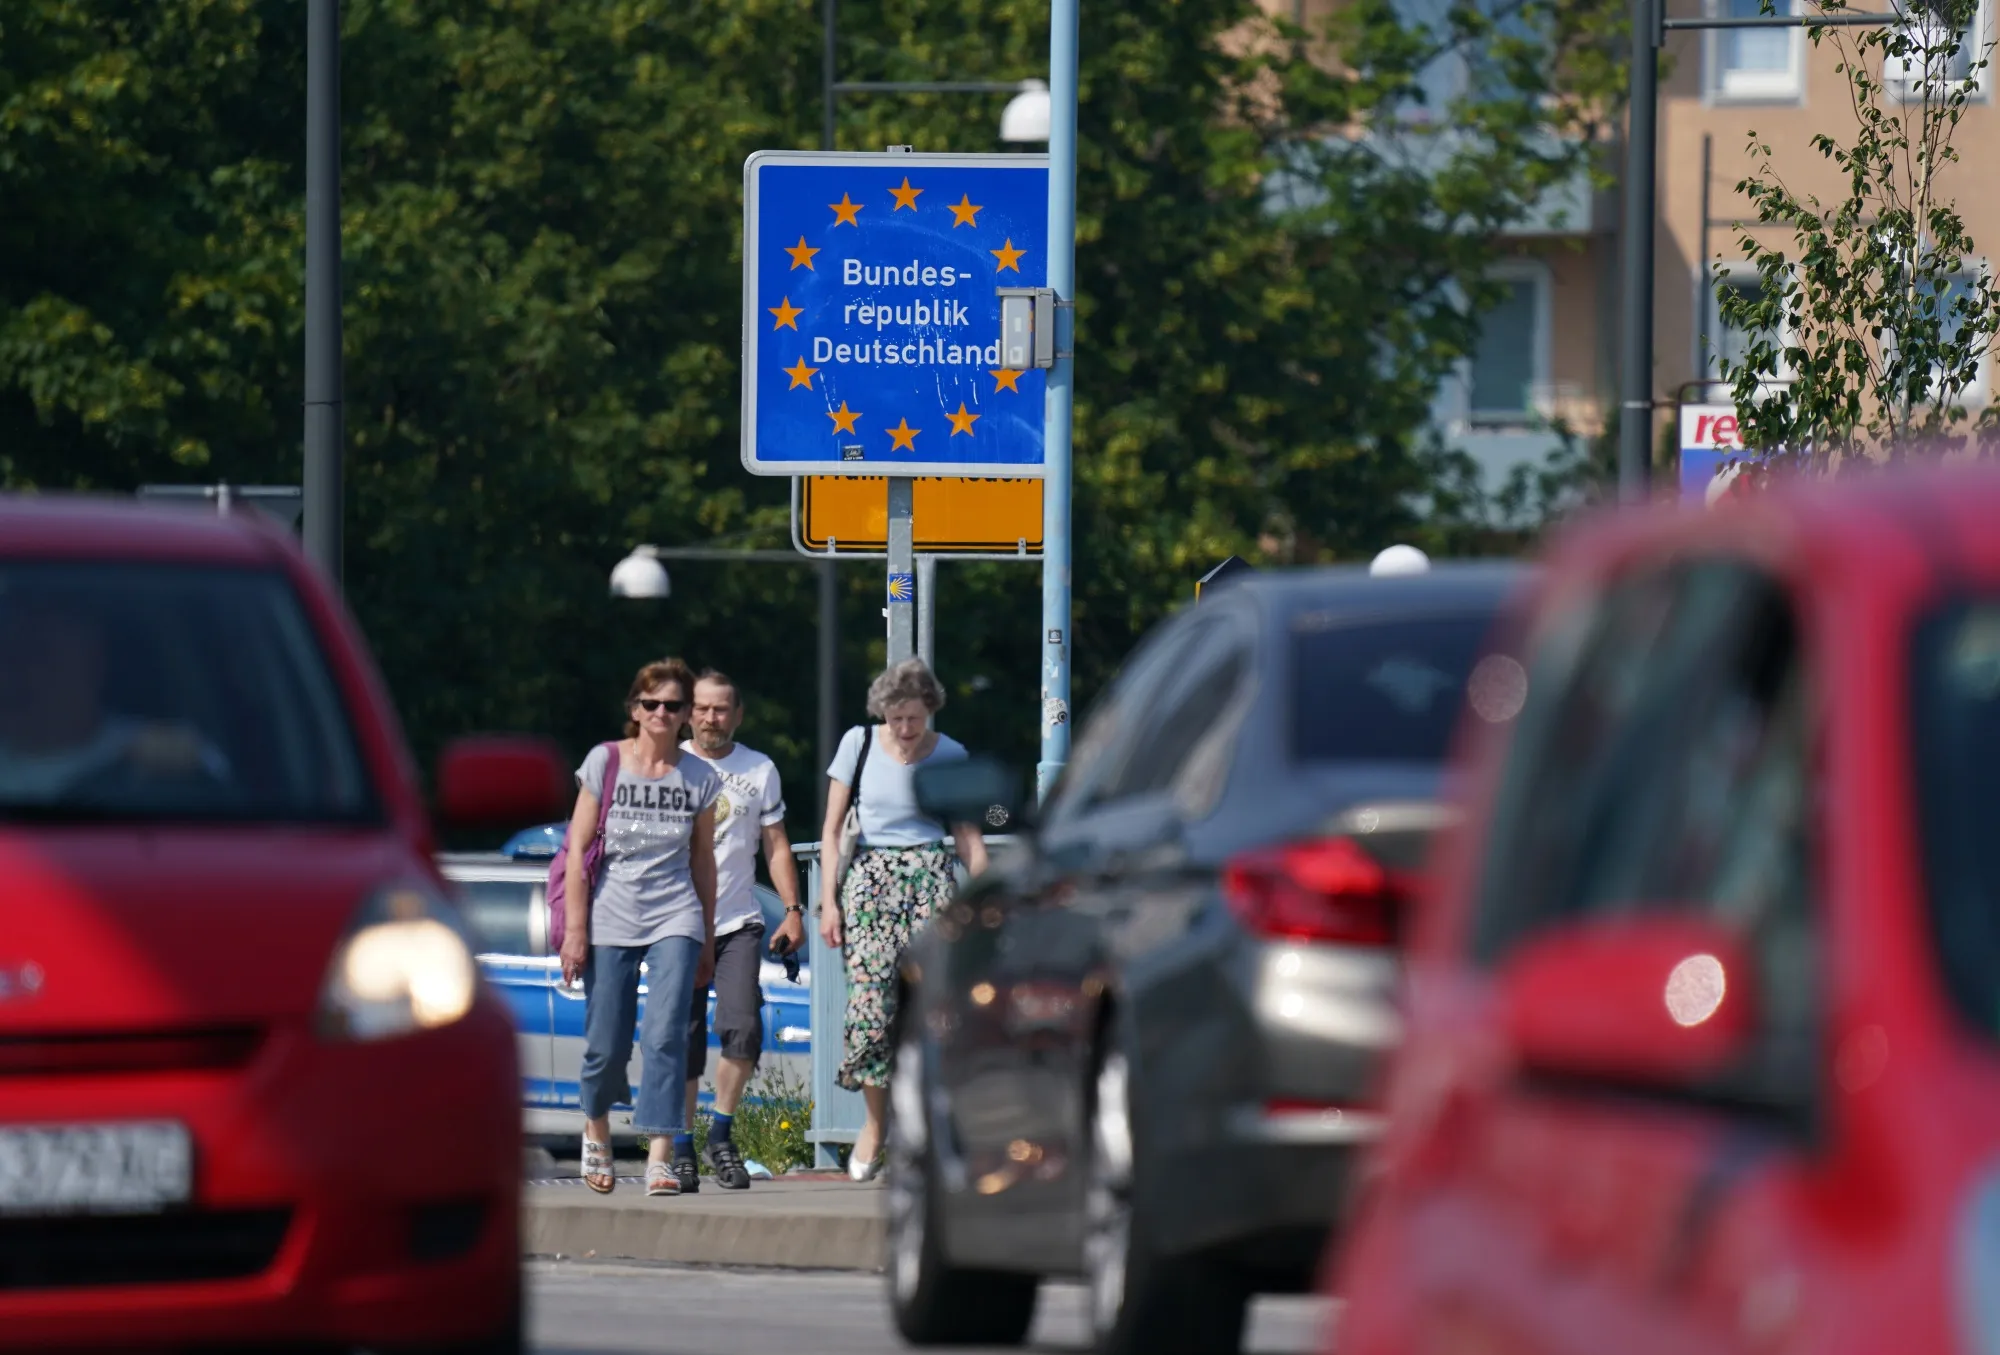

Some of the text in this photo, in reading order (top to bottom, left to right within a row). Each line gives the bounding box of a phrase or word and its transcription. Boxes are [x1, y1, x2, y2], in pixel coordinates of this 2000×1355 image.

[843, 258, 972, 287] Bundes-
[844, 299, 970, 332] republik
[813, 336, 1001, 366] Deutschland
[613, 783, 695, 812] OLLEGE
